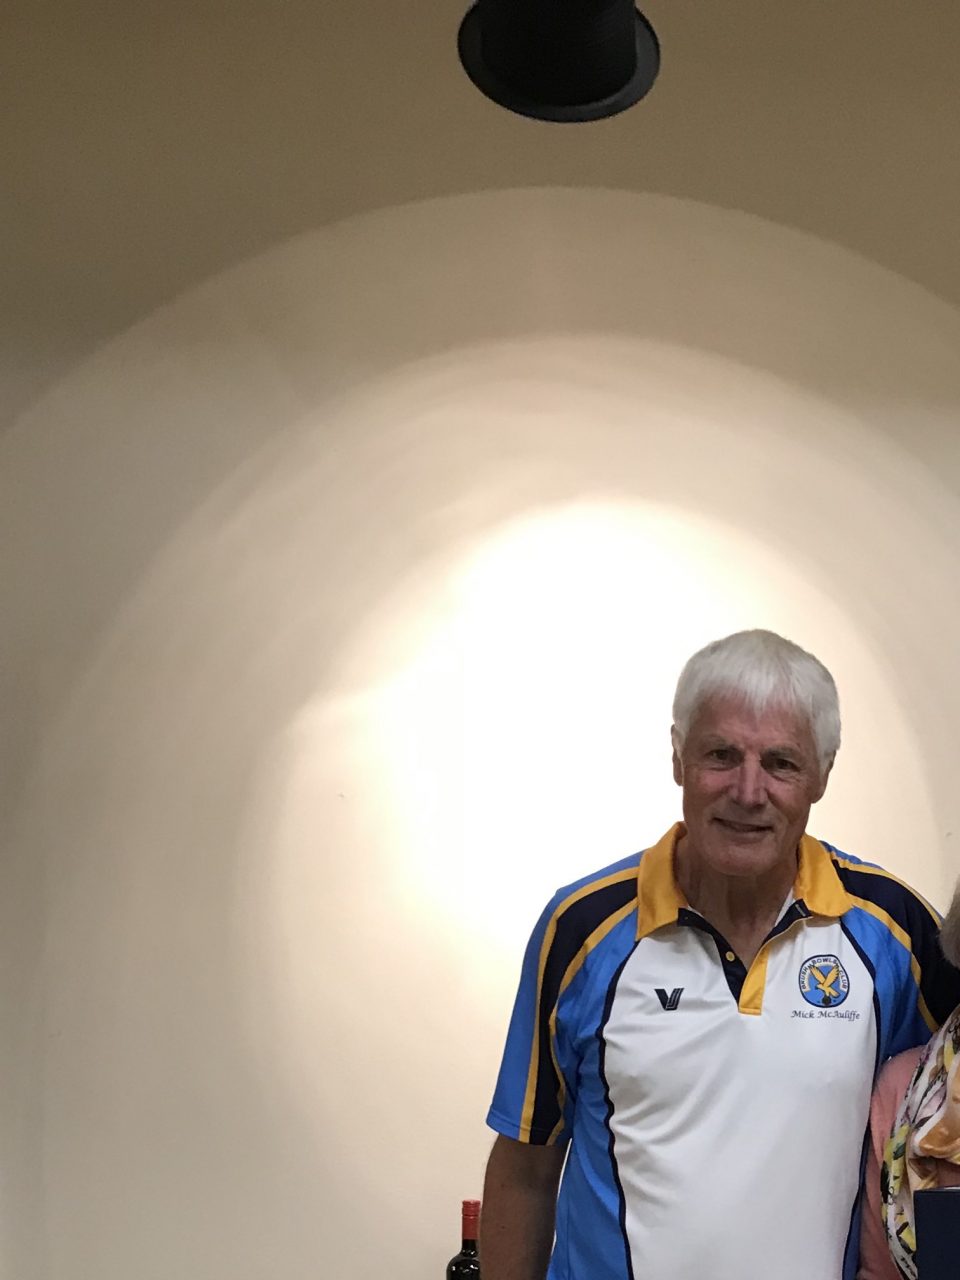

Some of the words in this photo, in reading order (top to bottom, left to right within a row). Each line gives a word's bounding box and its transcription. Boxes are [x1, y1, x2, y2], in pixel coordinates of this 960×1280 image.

[838, 970, 848, 989] CLUB
[790, 1009, 815, 1019] Mick
[817, 1009, 861, 1021] McAuliffe
